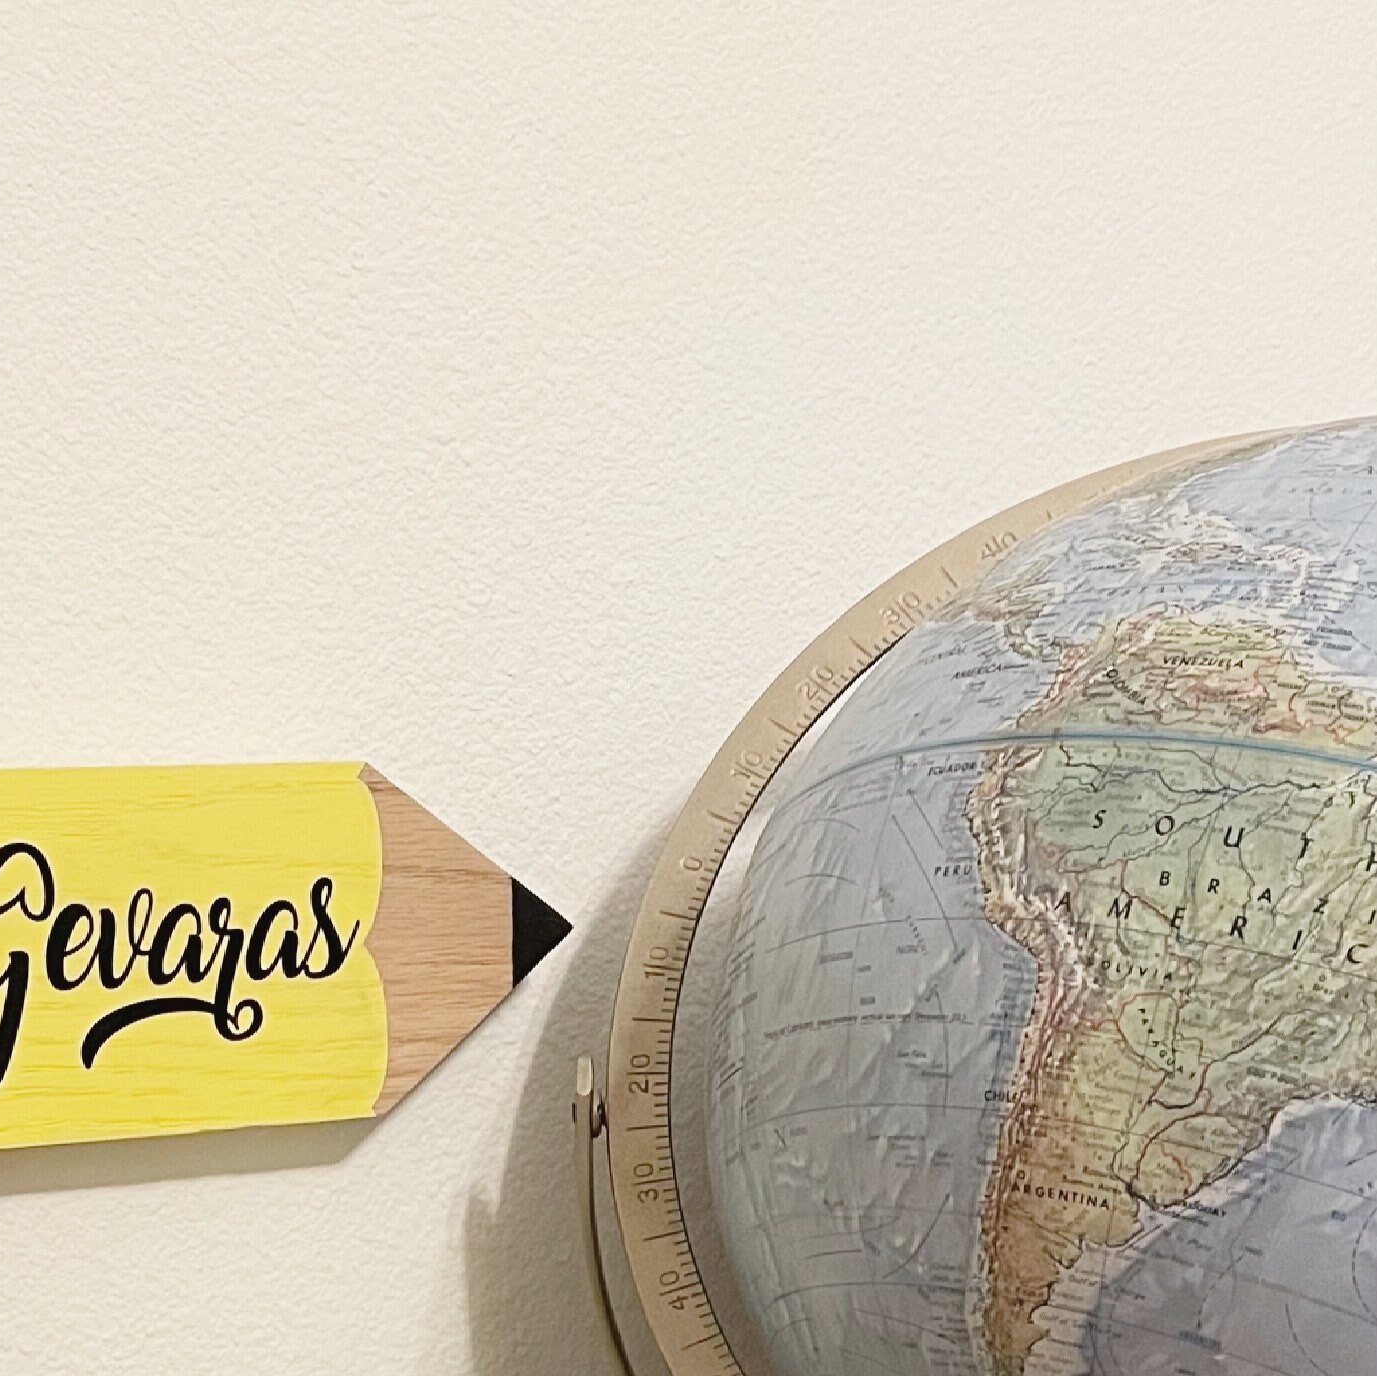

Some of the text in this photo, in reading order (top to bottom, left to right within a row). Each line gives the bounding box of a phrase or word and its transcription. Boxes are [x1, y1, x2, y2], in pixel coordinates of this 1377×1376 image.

[1163, 655, 1245, 671] VENEZUELA
[934, 864, 972, 877] PERU
[1158, 870, 1377, 925] BRAZI
[1054, 890, 1374, 965] AMERIC
[644, 945, 669, 979] 10
[627, 1052, 652, 1096] 20
[633, 1161, 660, 1205] 30
[1010, 1181, 1110, 1211] ARGENTINA
[659, 1269, 689, 1312] 40
